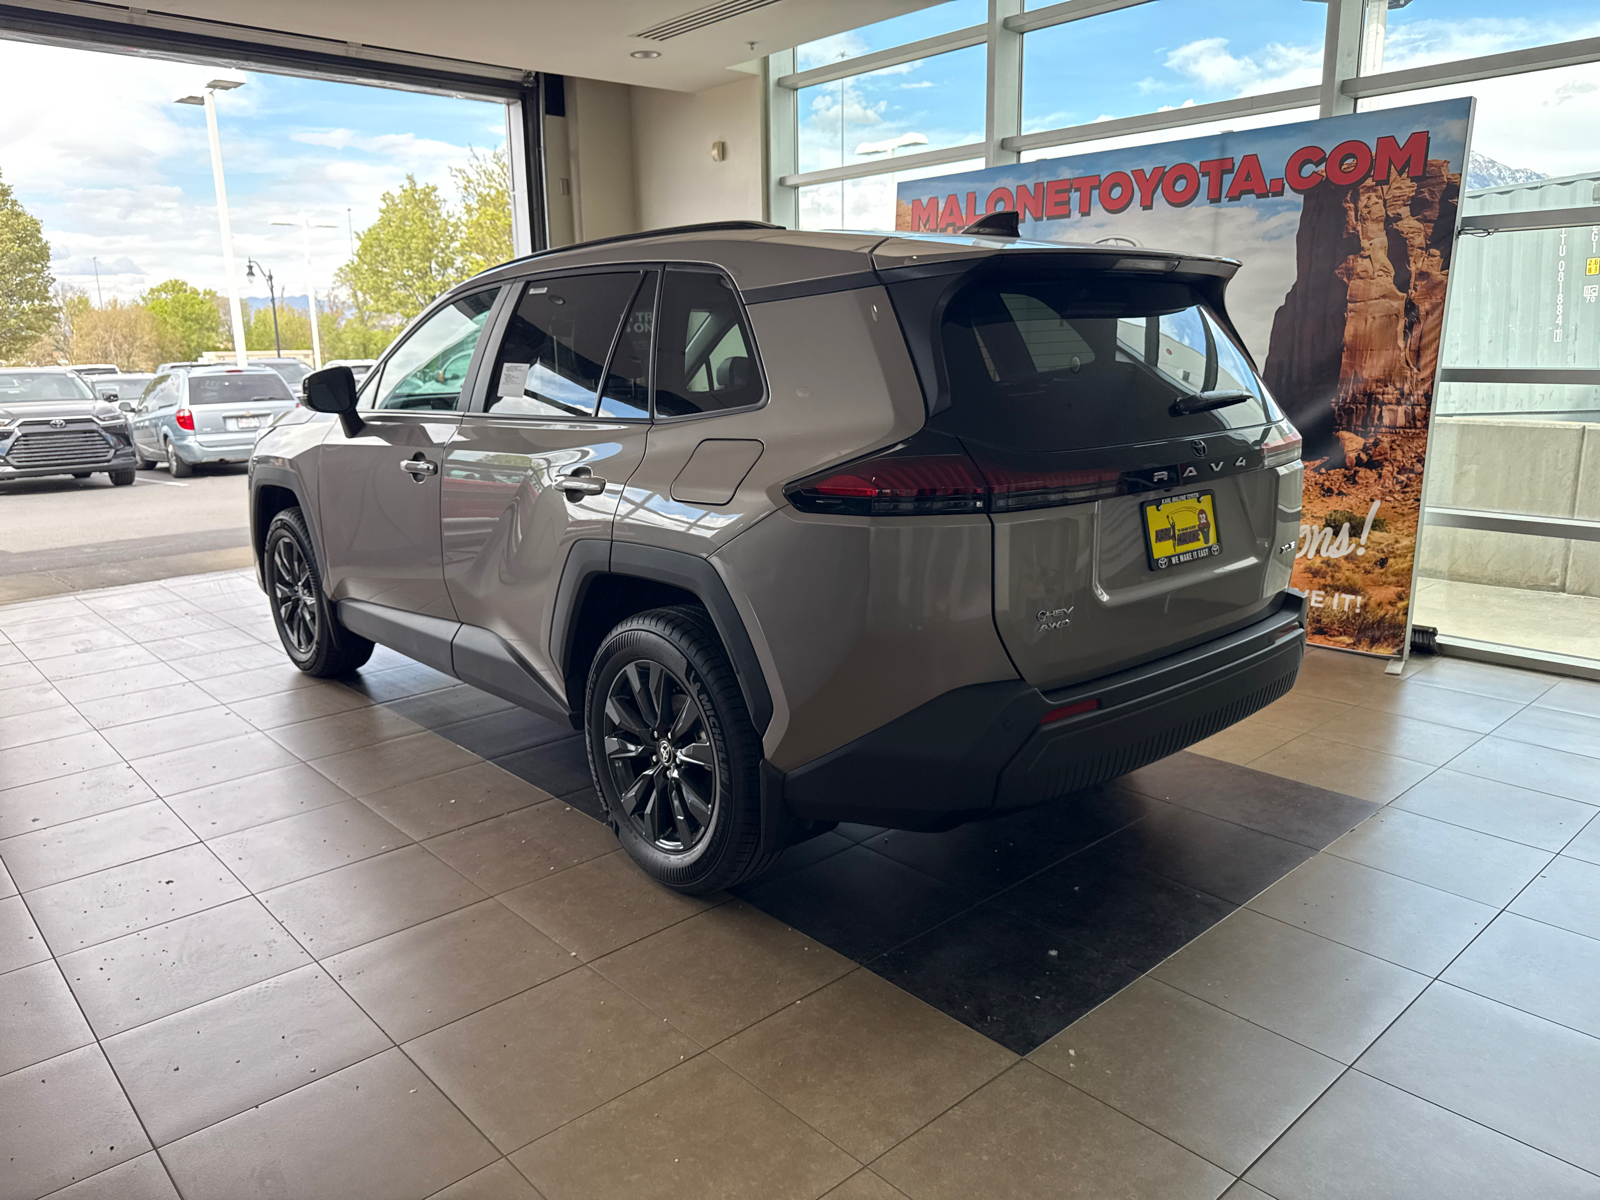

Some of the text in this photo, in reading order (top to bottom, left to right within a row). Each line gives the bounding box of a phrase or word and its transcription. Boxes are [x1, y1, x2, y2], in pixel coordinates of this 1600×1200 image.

[911, 130, 1430, 233] MALONETOYOTA.COM
[1153, 456, 1246, 482] RAV4
[1171, 548, 1209, 565] WE MAKE IT EASY
[1306, 589, 1362, 613] E IT!
[1039, 618, 1070, 631] AWD
[698, 692, 731, 788] MICHELIN
